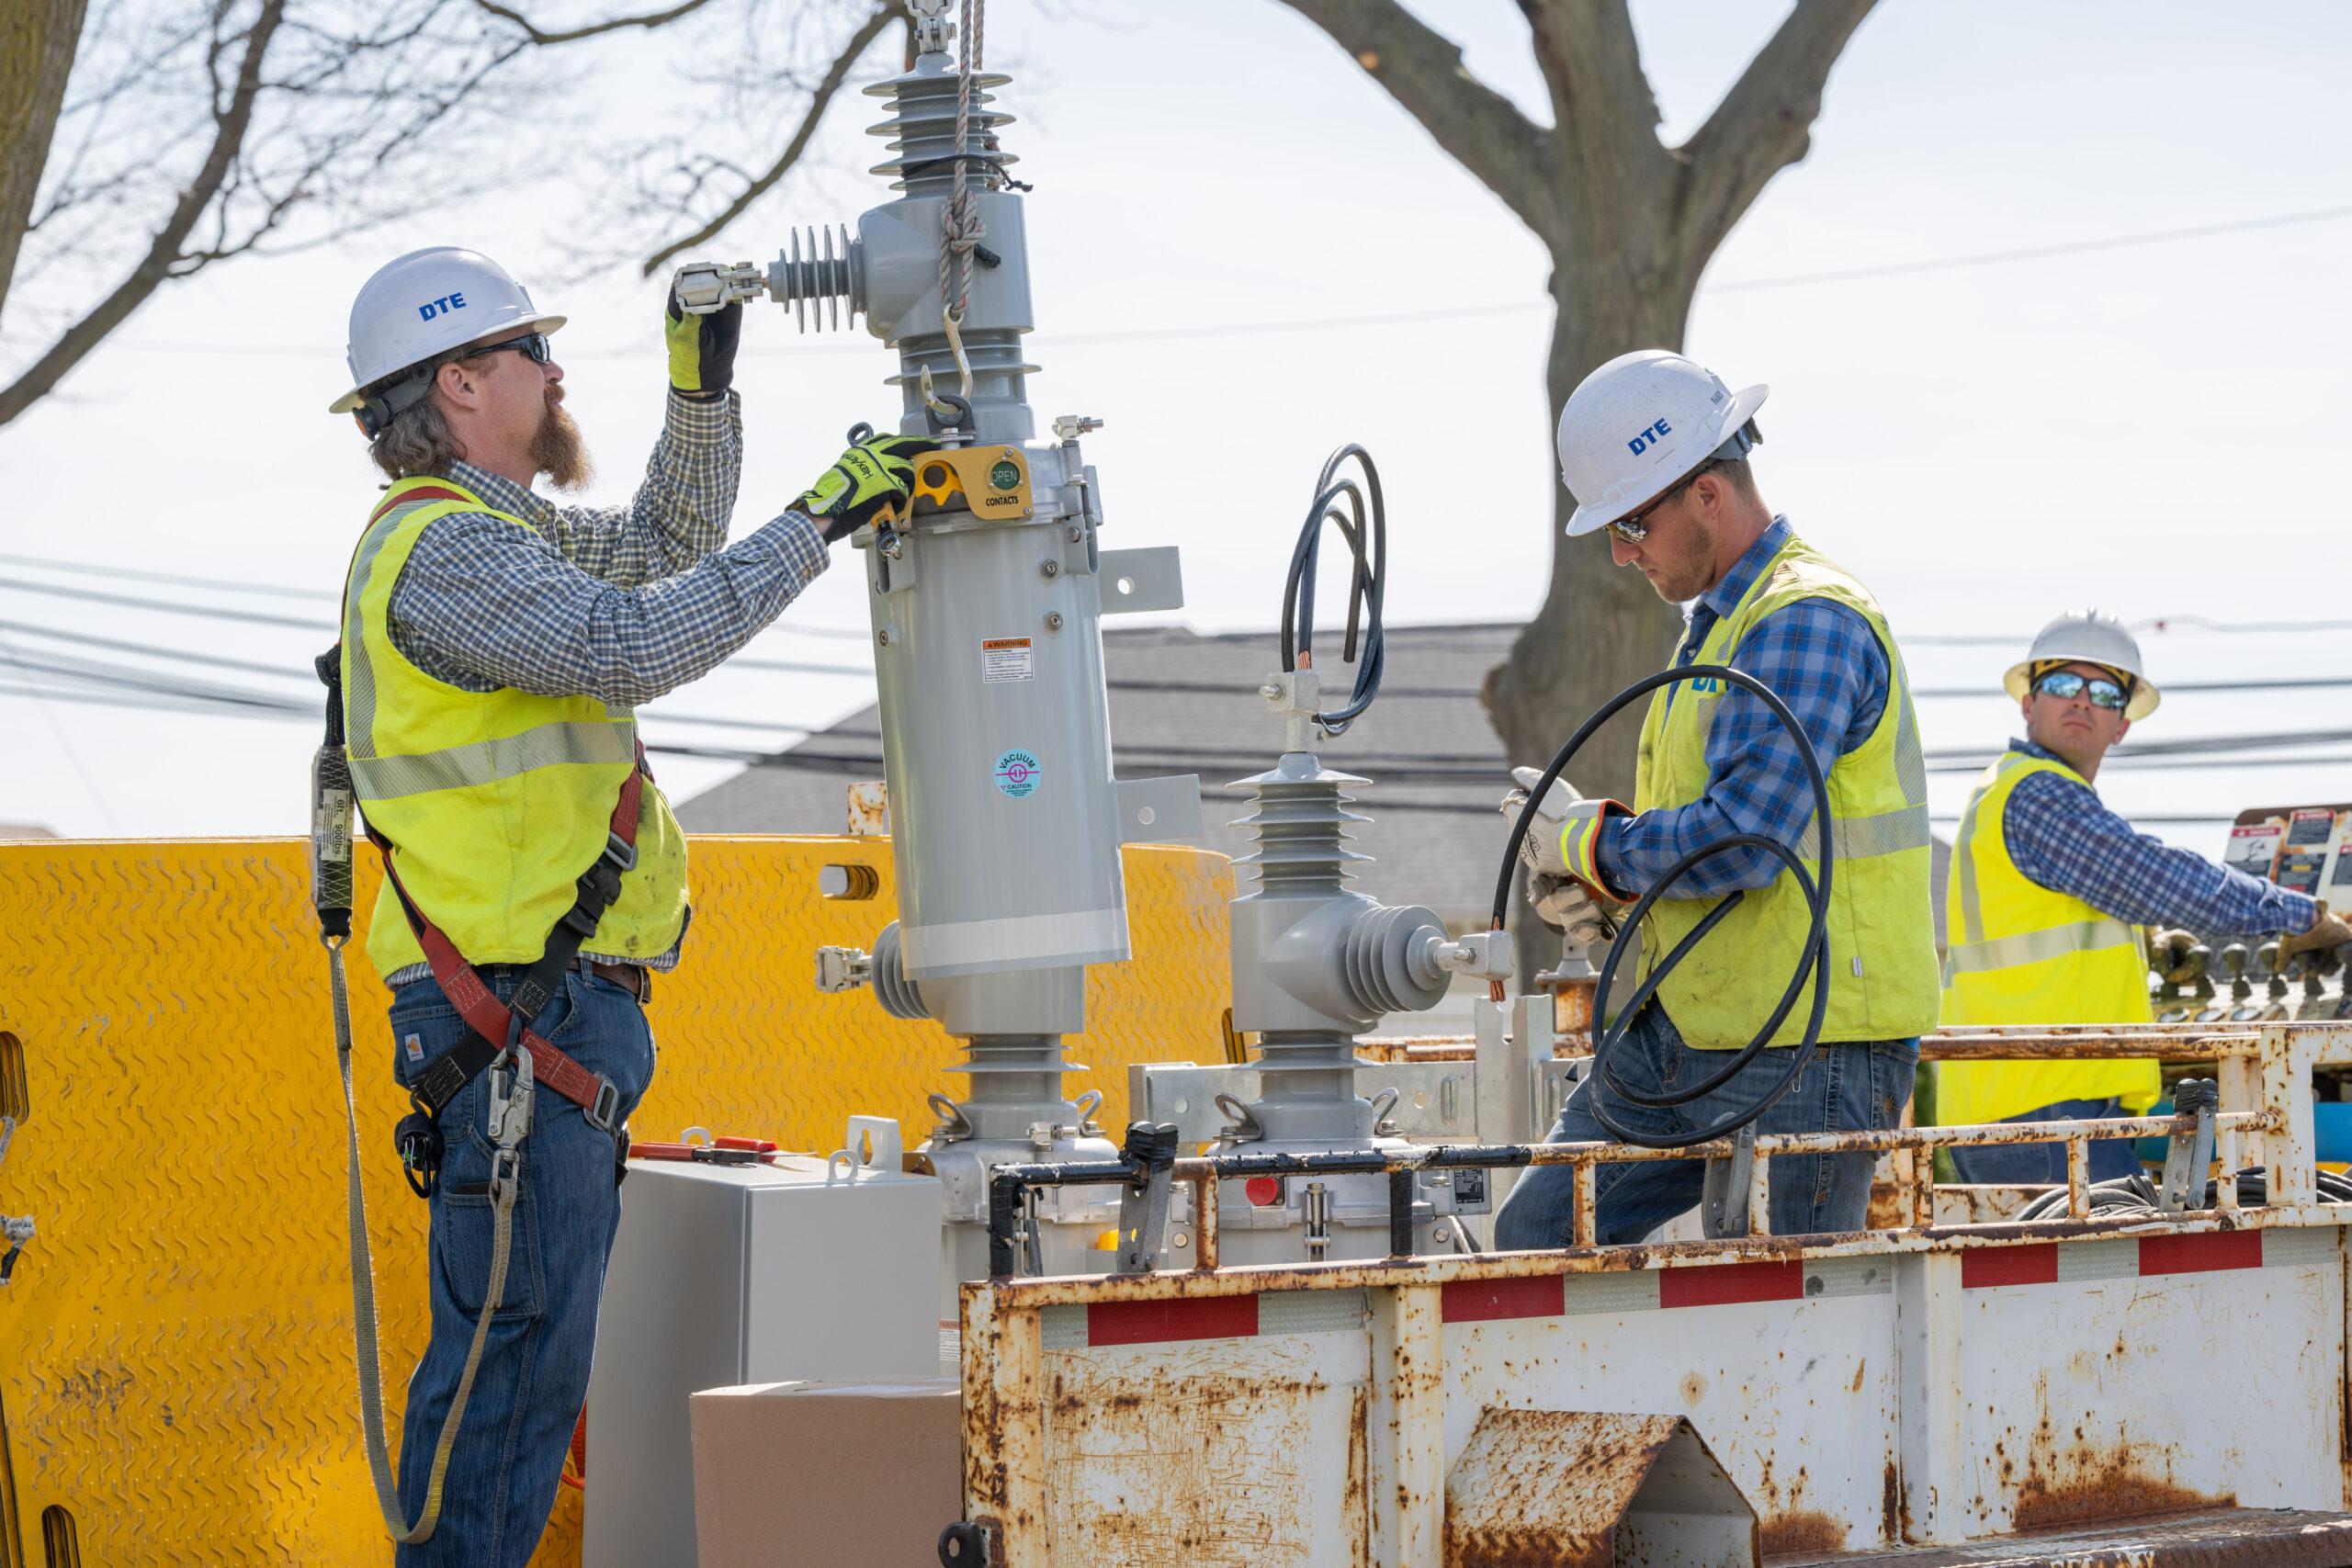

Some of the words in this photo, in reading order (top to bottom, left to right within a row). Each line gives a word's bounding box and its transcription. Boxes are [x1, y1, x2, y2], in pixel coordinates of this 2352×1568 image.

[419, 293, 467, 321] DTE
[1628, 418, 1672, 456] DTE
[992, 471, 1017, 482] OPEN
[986, 496, 1019, 506] CONTACTS
[993, 639, 1027, 648] WARNING
[1000, 753, 1035, 769] VACUUM
[336, 799, 345, 816] 6ft.
[334, 824, 343, 857] 900lbs.
